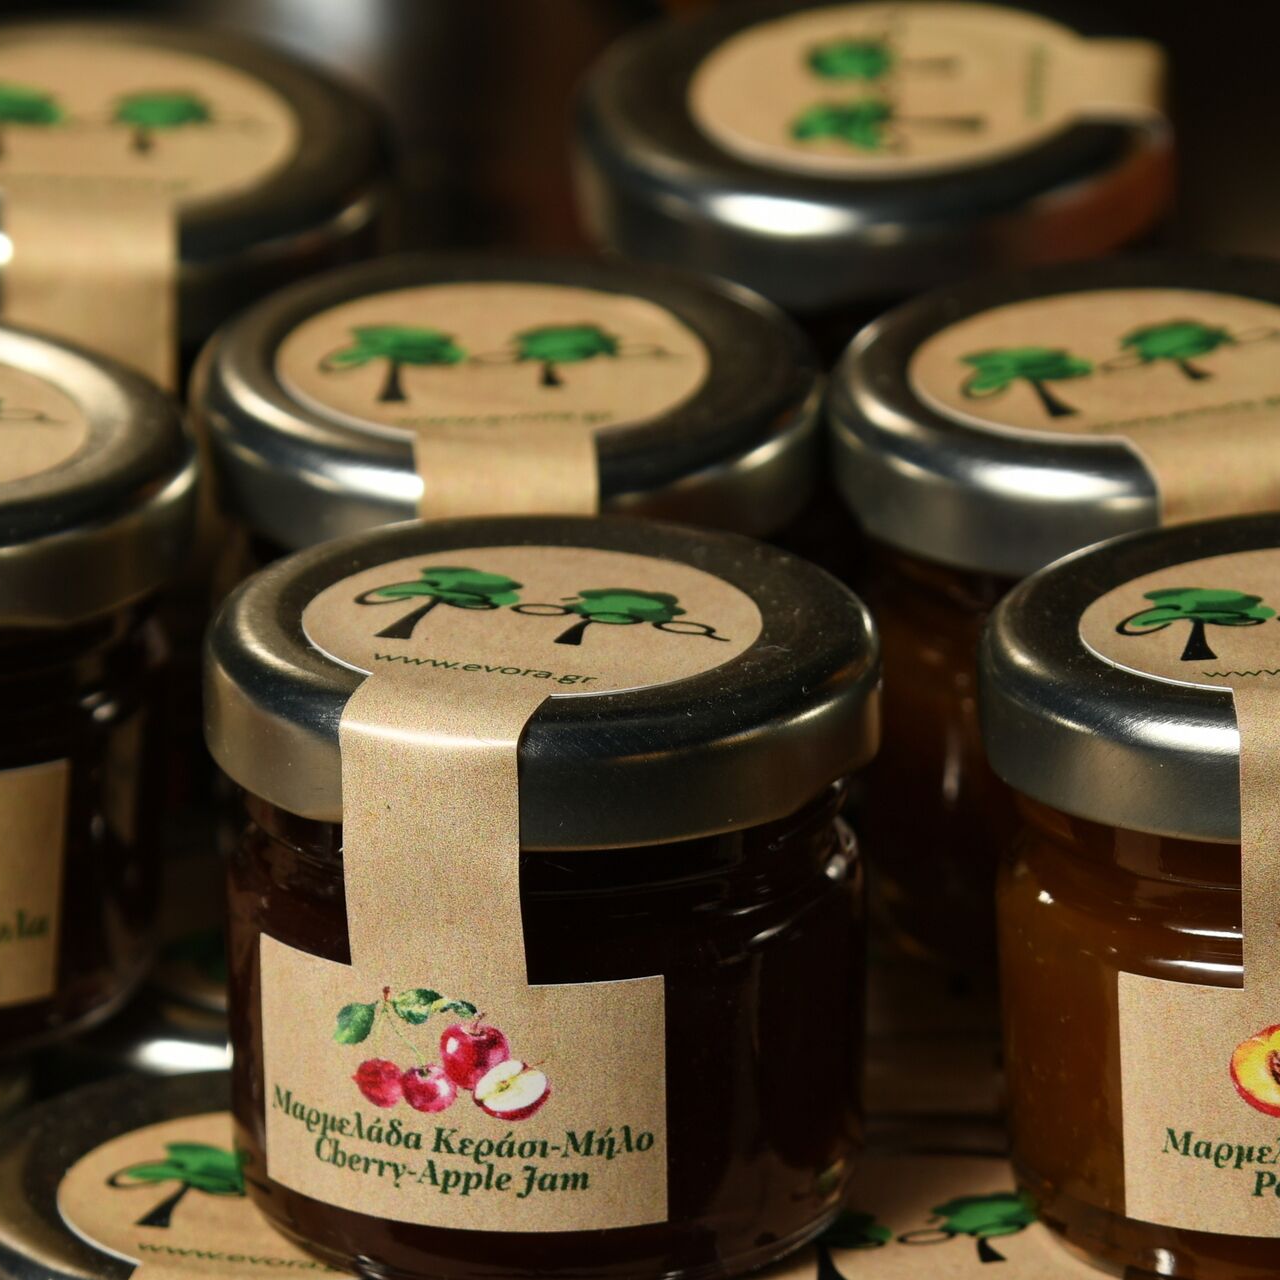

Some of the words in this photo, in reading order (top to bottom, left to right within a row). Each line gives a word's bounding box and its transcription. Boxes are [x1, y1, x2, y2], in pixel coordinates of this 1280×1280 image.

[373, 651, 598, 685] www.evora.gr
[272, 1084, 423, 1151] Μαρμελάδα
[431, 1125, 655, 1165] Κεράσι-Μήλο
[314, 1136, 513, 1196] Cherry-Apple
[516, 1164, 590, 1199] Jam
